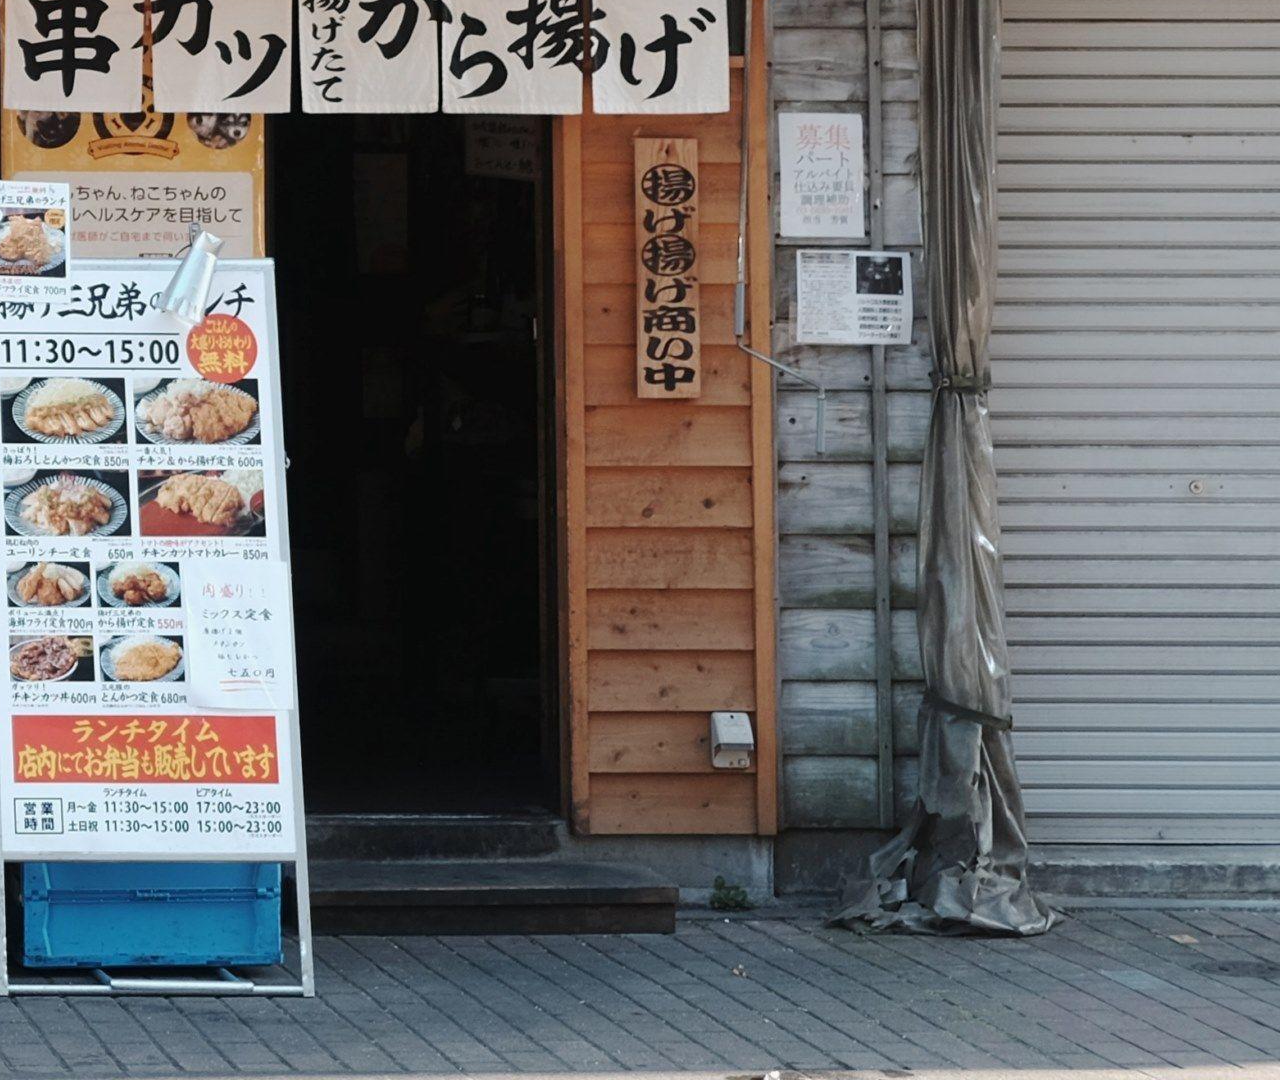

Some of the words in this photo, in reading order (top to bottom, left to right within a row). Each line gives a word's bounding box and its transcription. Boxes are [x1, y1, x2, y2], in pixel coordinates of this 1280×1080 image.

[796, 123, 851, 150] 募集
[796, 151, 850, 168] パート
[793, 169, 854, 179] アルバイト
[71, 185, 226, 201] ちゃん、ねこちゃんの
[43, 286, 67, 296] 700円
[205, 318, 239, 334] ごはんの
[197, 349, 249, 374] 無料
[2, 454, 101, 466] 梅おろしとんかつ定食
[103, 455, 130, 467] 850円
[237, 456, 263, 468] 600円
[6, 546, 92, 558] ユーリンチー定食
[107, 548, 134, 560] 650円
[141, 548, 240, 559] チキンカツトマトカレー
[242, 549, 269, 560] 850円
[201, 607, 273, 621] ミックス定食
[8, 617, 66, 629] 海鮮フライ定食
[67, 619, 94, 630] 700円
[97, 617, 156, 629] から揚げ定食
[157, 619, 183, 630] 550円
[11, 691, 70, 703] チキンカツ丼
[70, 693, 97, 704] 600円
[101, 691, 158, 703] とんかつ定食
[160, 693, 188, 704] 680円
[71, 719, 220, 743] ランチタイム
[17, 743, 275, 781] 店内にてお弁当も販売しています
[102, 787, 148, 798] ランチタイム
[23, 801, 55, 816] 営業
[23, 817, 56, 831] 時間
[68, 819, 99, 832] 土日祝
